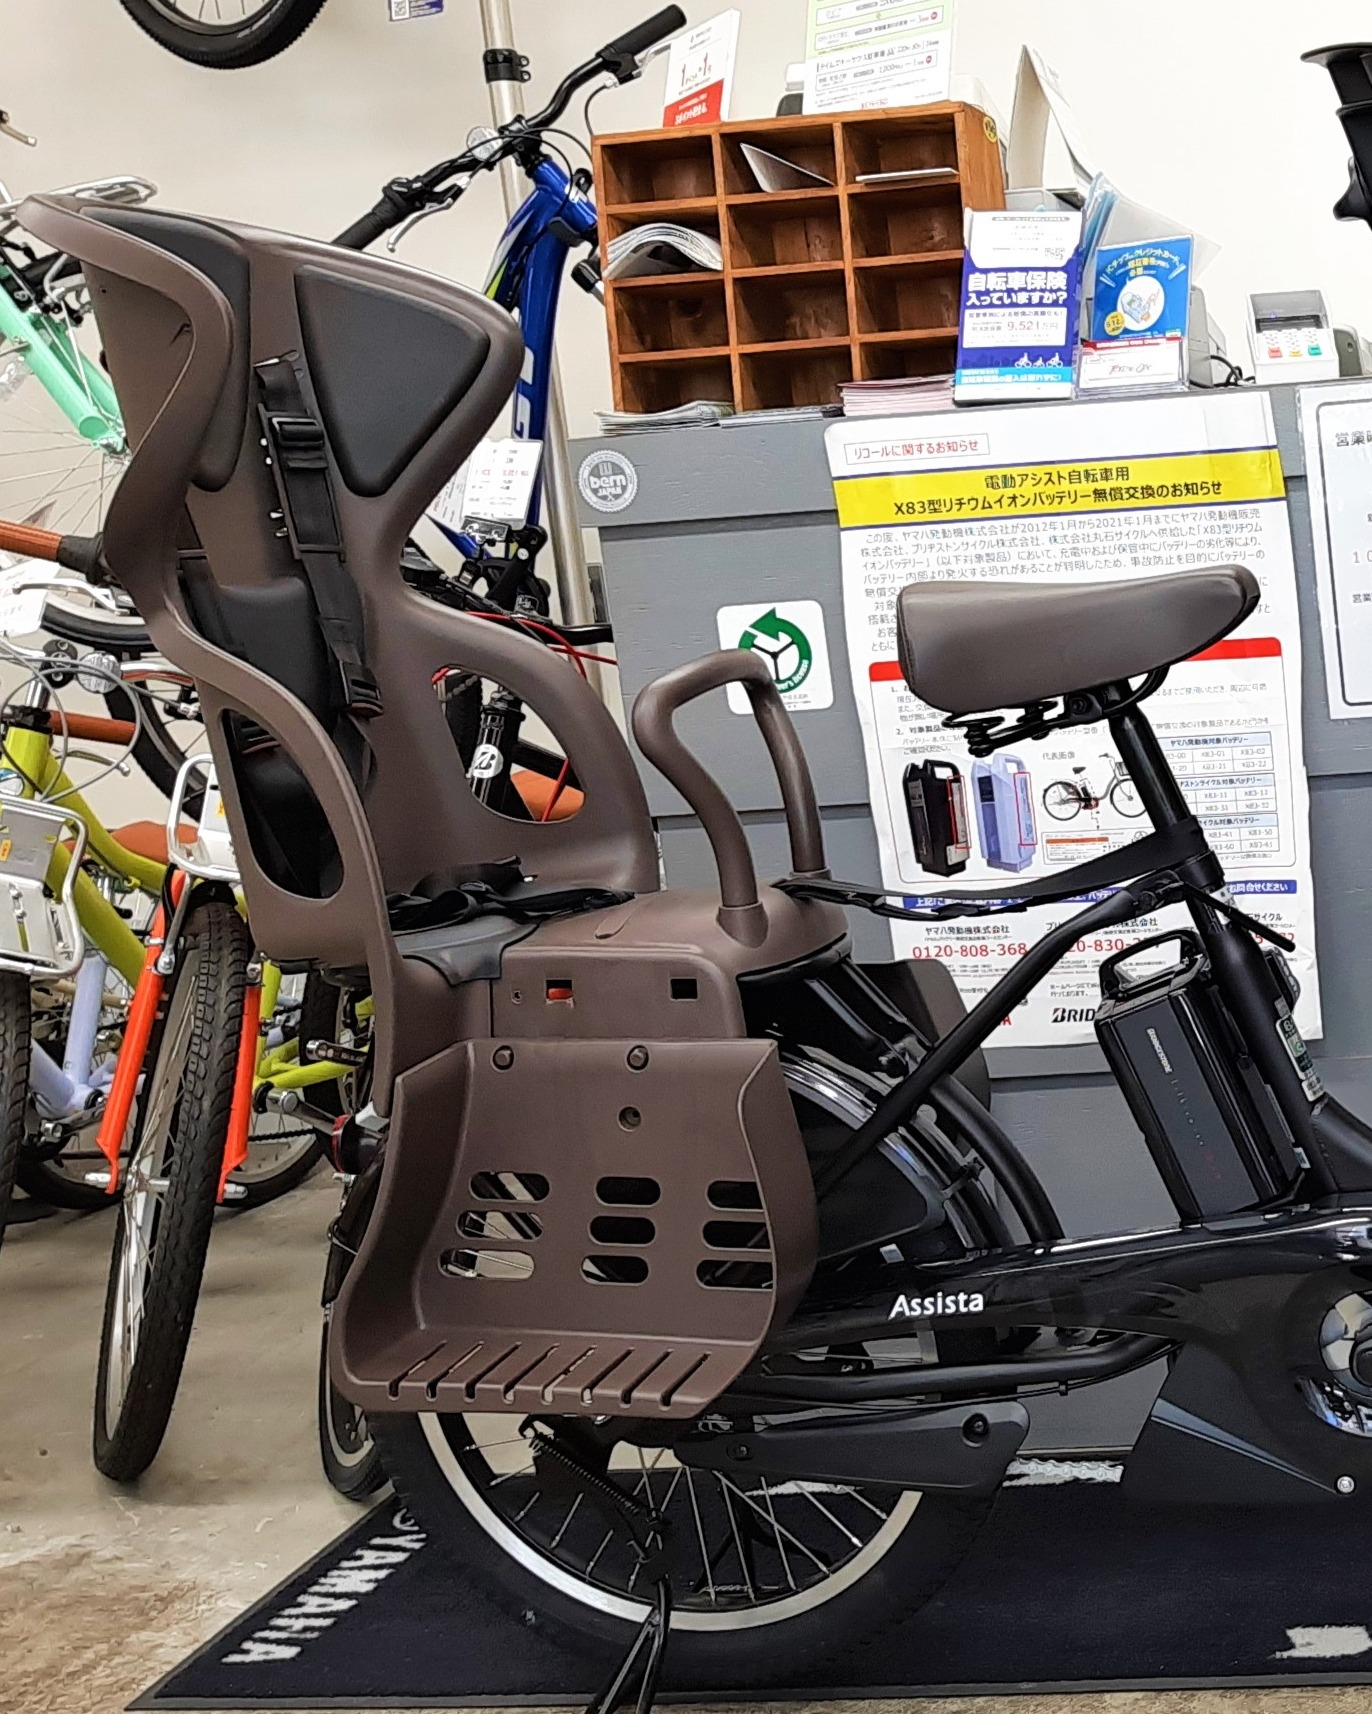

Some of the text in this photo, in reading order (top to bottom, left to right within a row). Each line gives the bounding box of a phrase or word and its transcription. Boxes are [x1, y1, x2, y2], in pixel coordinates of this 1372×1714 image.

[967, 271, 1067, 291] 自転車保険
[966, 291, 1067, 306] 入っていますか？
[854, 440, 979, 460] リコールに関するお知らせ
[984, 466, 1130, 490] 電動アシスト自転車用
[894, 481, 1223, 515] X83型リチウムイオンバッテリー無償交換のお知らせ
[864, 586, 902, 598] 無償交
[925, 925, 1010, 935] ヤマハ発動機株式会社
[912, 942, 1028, 959] 0120-808-368
[888, 1291, 984, 1320] Assista
[220, 1533, 428, 1663] YAMAHA
